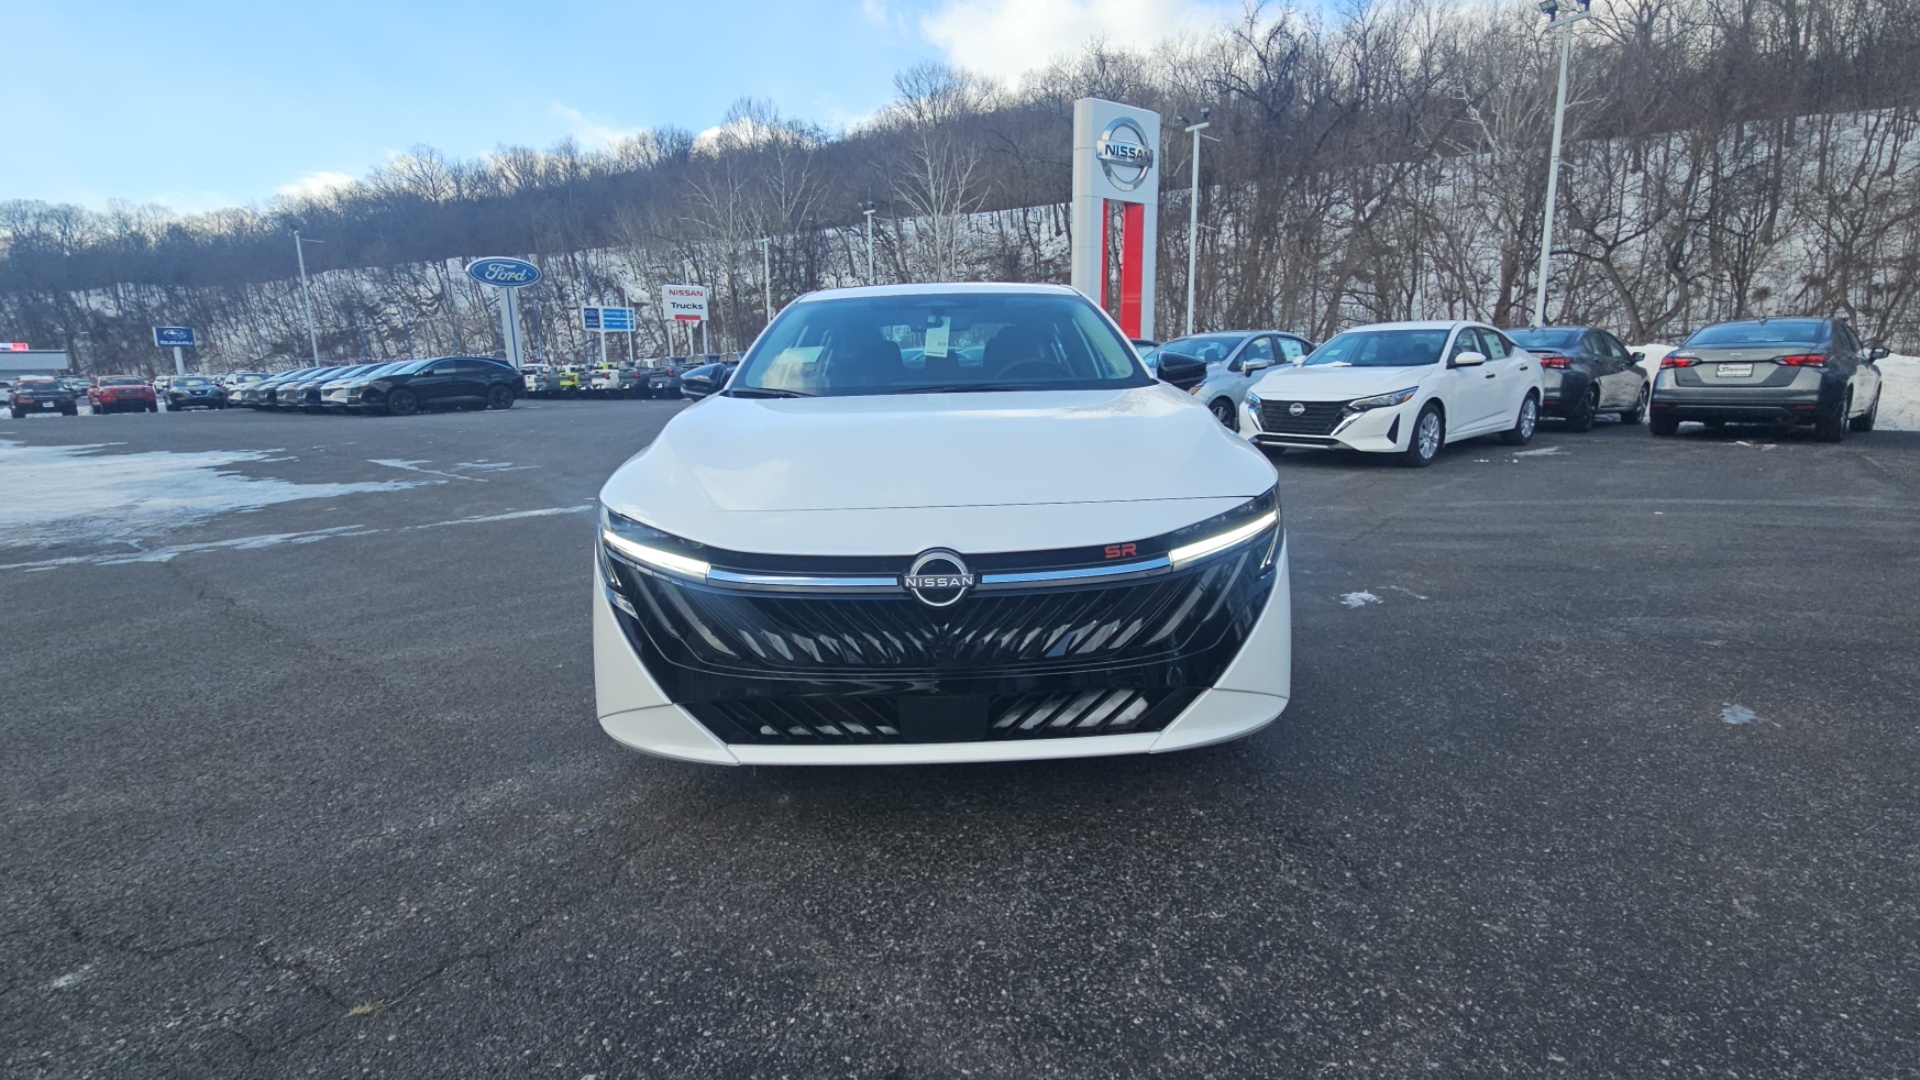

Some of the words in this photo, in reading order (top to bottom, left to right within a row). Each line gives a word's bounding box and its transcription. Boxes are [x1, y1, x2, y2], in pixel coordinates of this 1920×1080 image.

[1105, 144, 1150, 162] NISSAN
[485, 263, 527, 281] Ford
[669, 289, 704, 297] NISSAN
[670, 302, 704, 310] Trucks
[1104, 543, 1138, 559] SR
[905, 576, 974, 587] NISSAN
